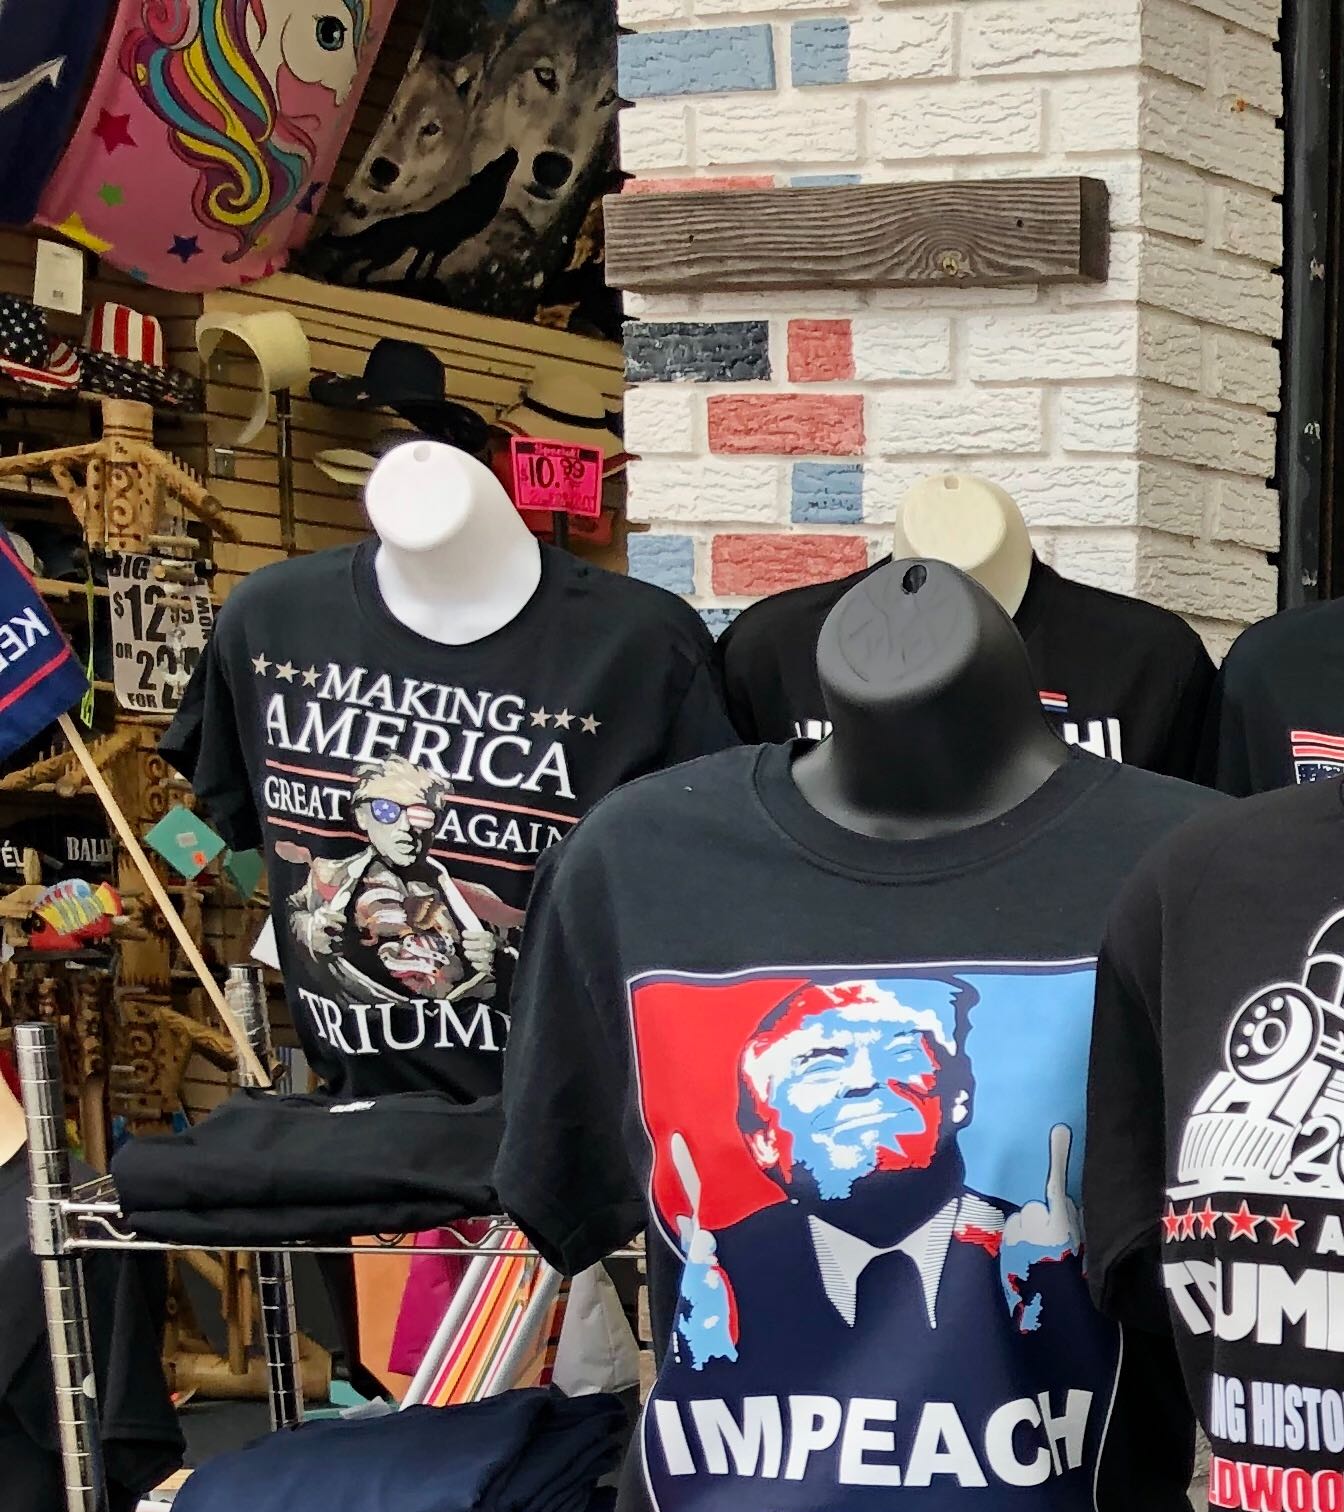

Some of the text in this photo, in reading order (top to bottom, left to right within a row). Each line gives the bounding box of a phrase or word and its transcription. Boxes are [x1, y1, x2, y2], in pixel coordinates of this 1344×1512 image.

[316, 662, 525, 732] MAKING
[264, 691, 578, 799] AMERICA
[263, 772, 350, 822] GREAT
[299, 987, 511, 1056] TRIUM
[653, 1388, 1093, 1488] IMPEACH
